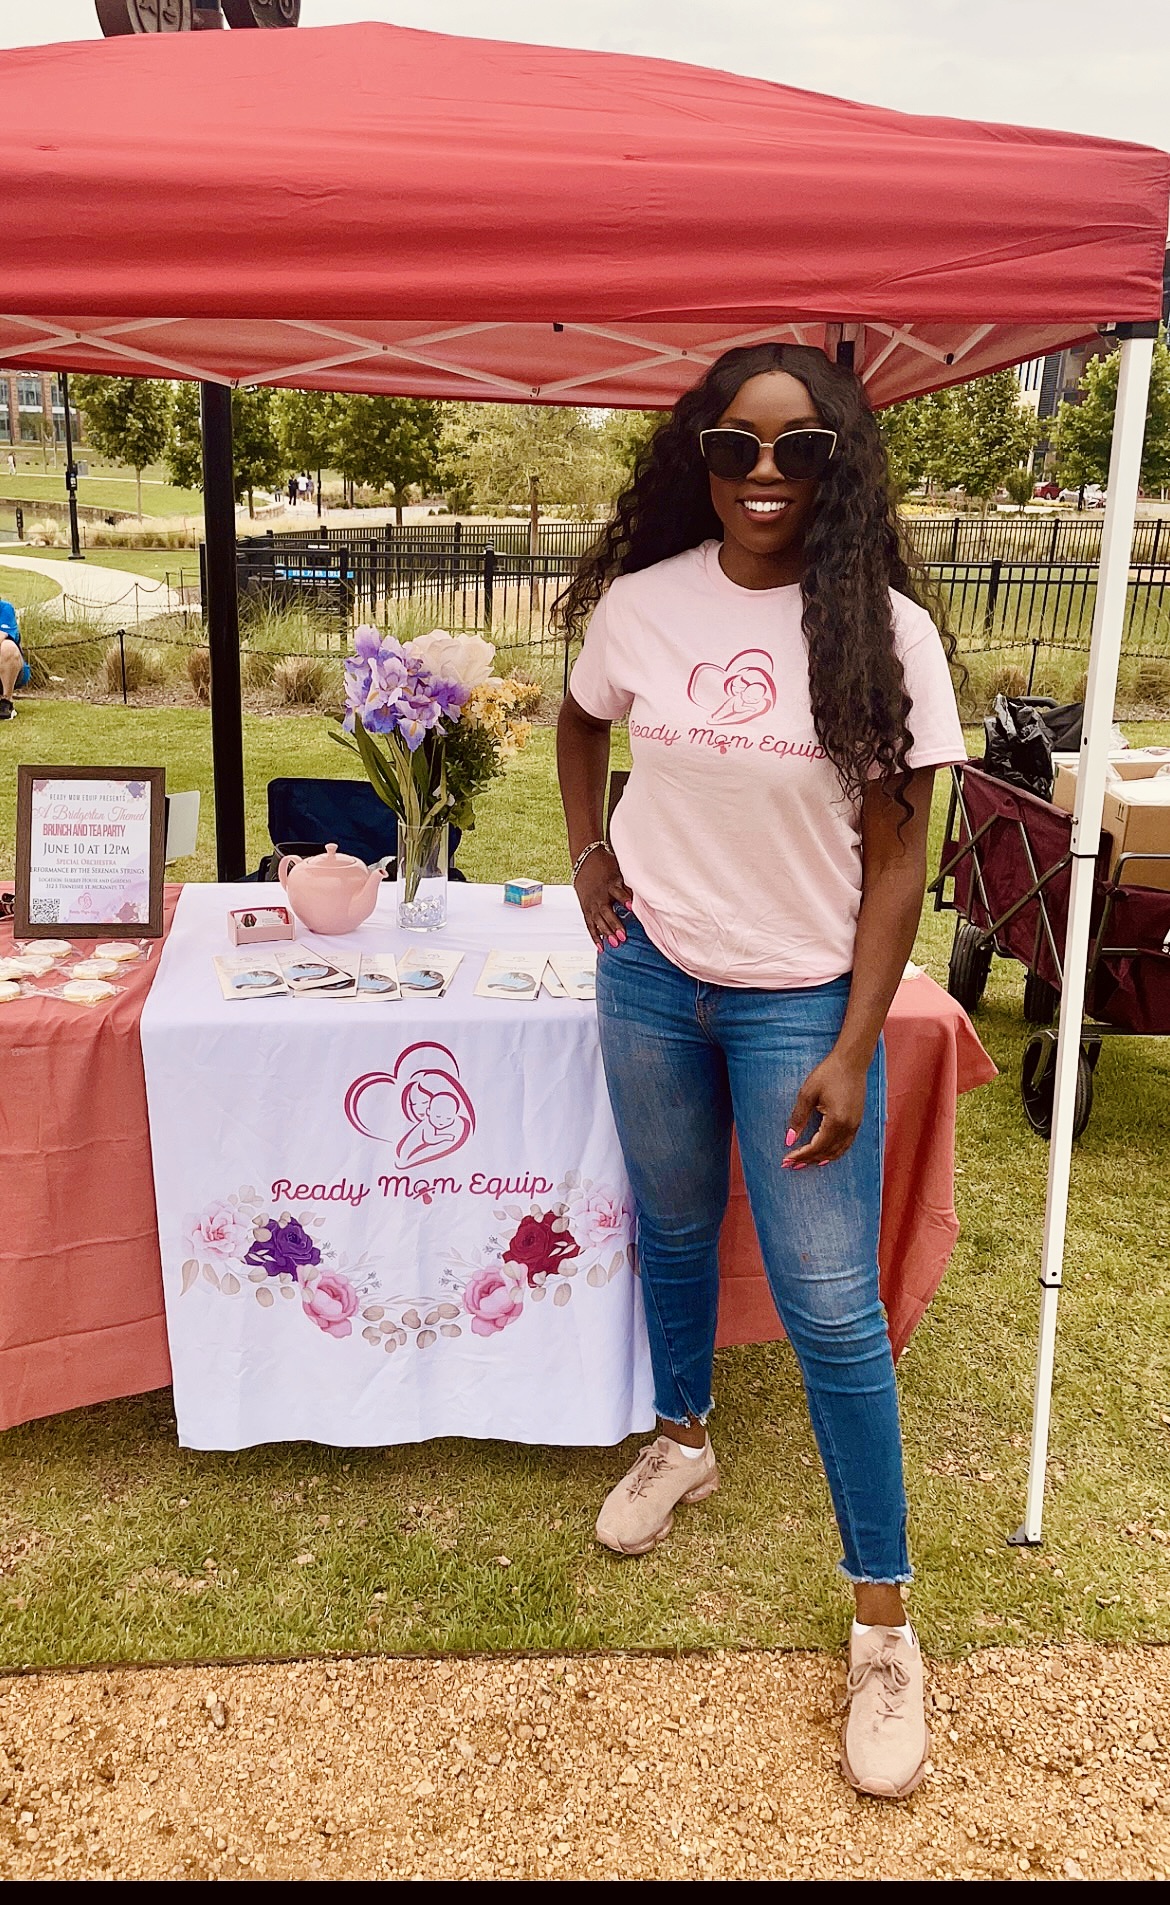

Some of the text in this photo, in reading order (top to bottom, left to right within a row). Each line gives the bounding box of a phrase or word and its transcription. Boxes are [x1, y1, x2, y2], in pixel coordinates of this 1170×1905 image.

[631, 720, 828, 762] eady Mom Equip
[49, 793, 66, 801] READY
[99, 794, 126, 802] PRESENTS
[52, 804, 105, 824] Bridgerton
[107, 806, 148, 822] Themed
[43, 823, 126, 837] BRUNCH AND TEA PARTY
[43, 842, 69, 856] JUNE
[73, 843, 85, 854] 10
[87, 844, 100, 854] AT
[271, 1171, 554, 1206] Ready Mom Equip
